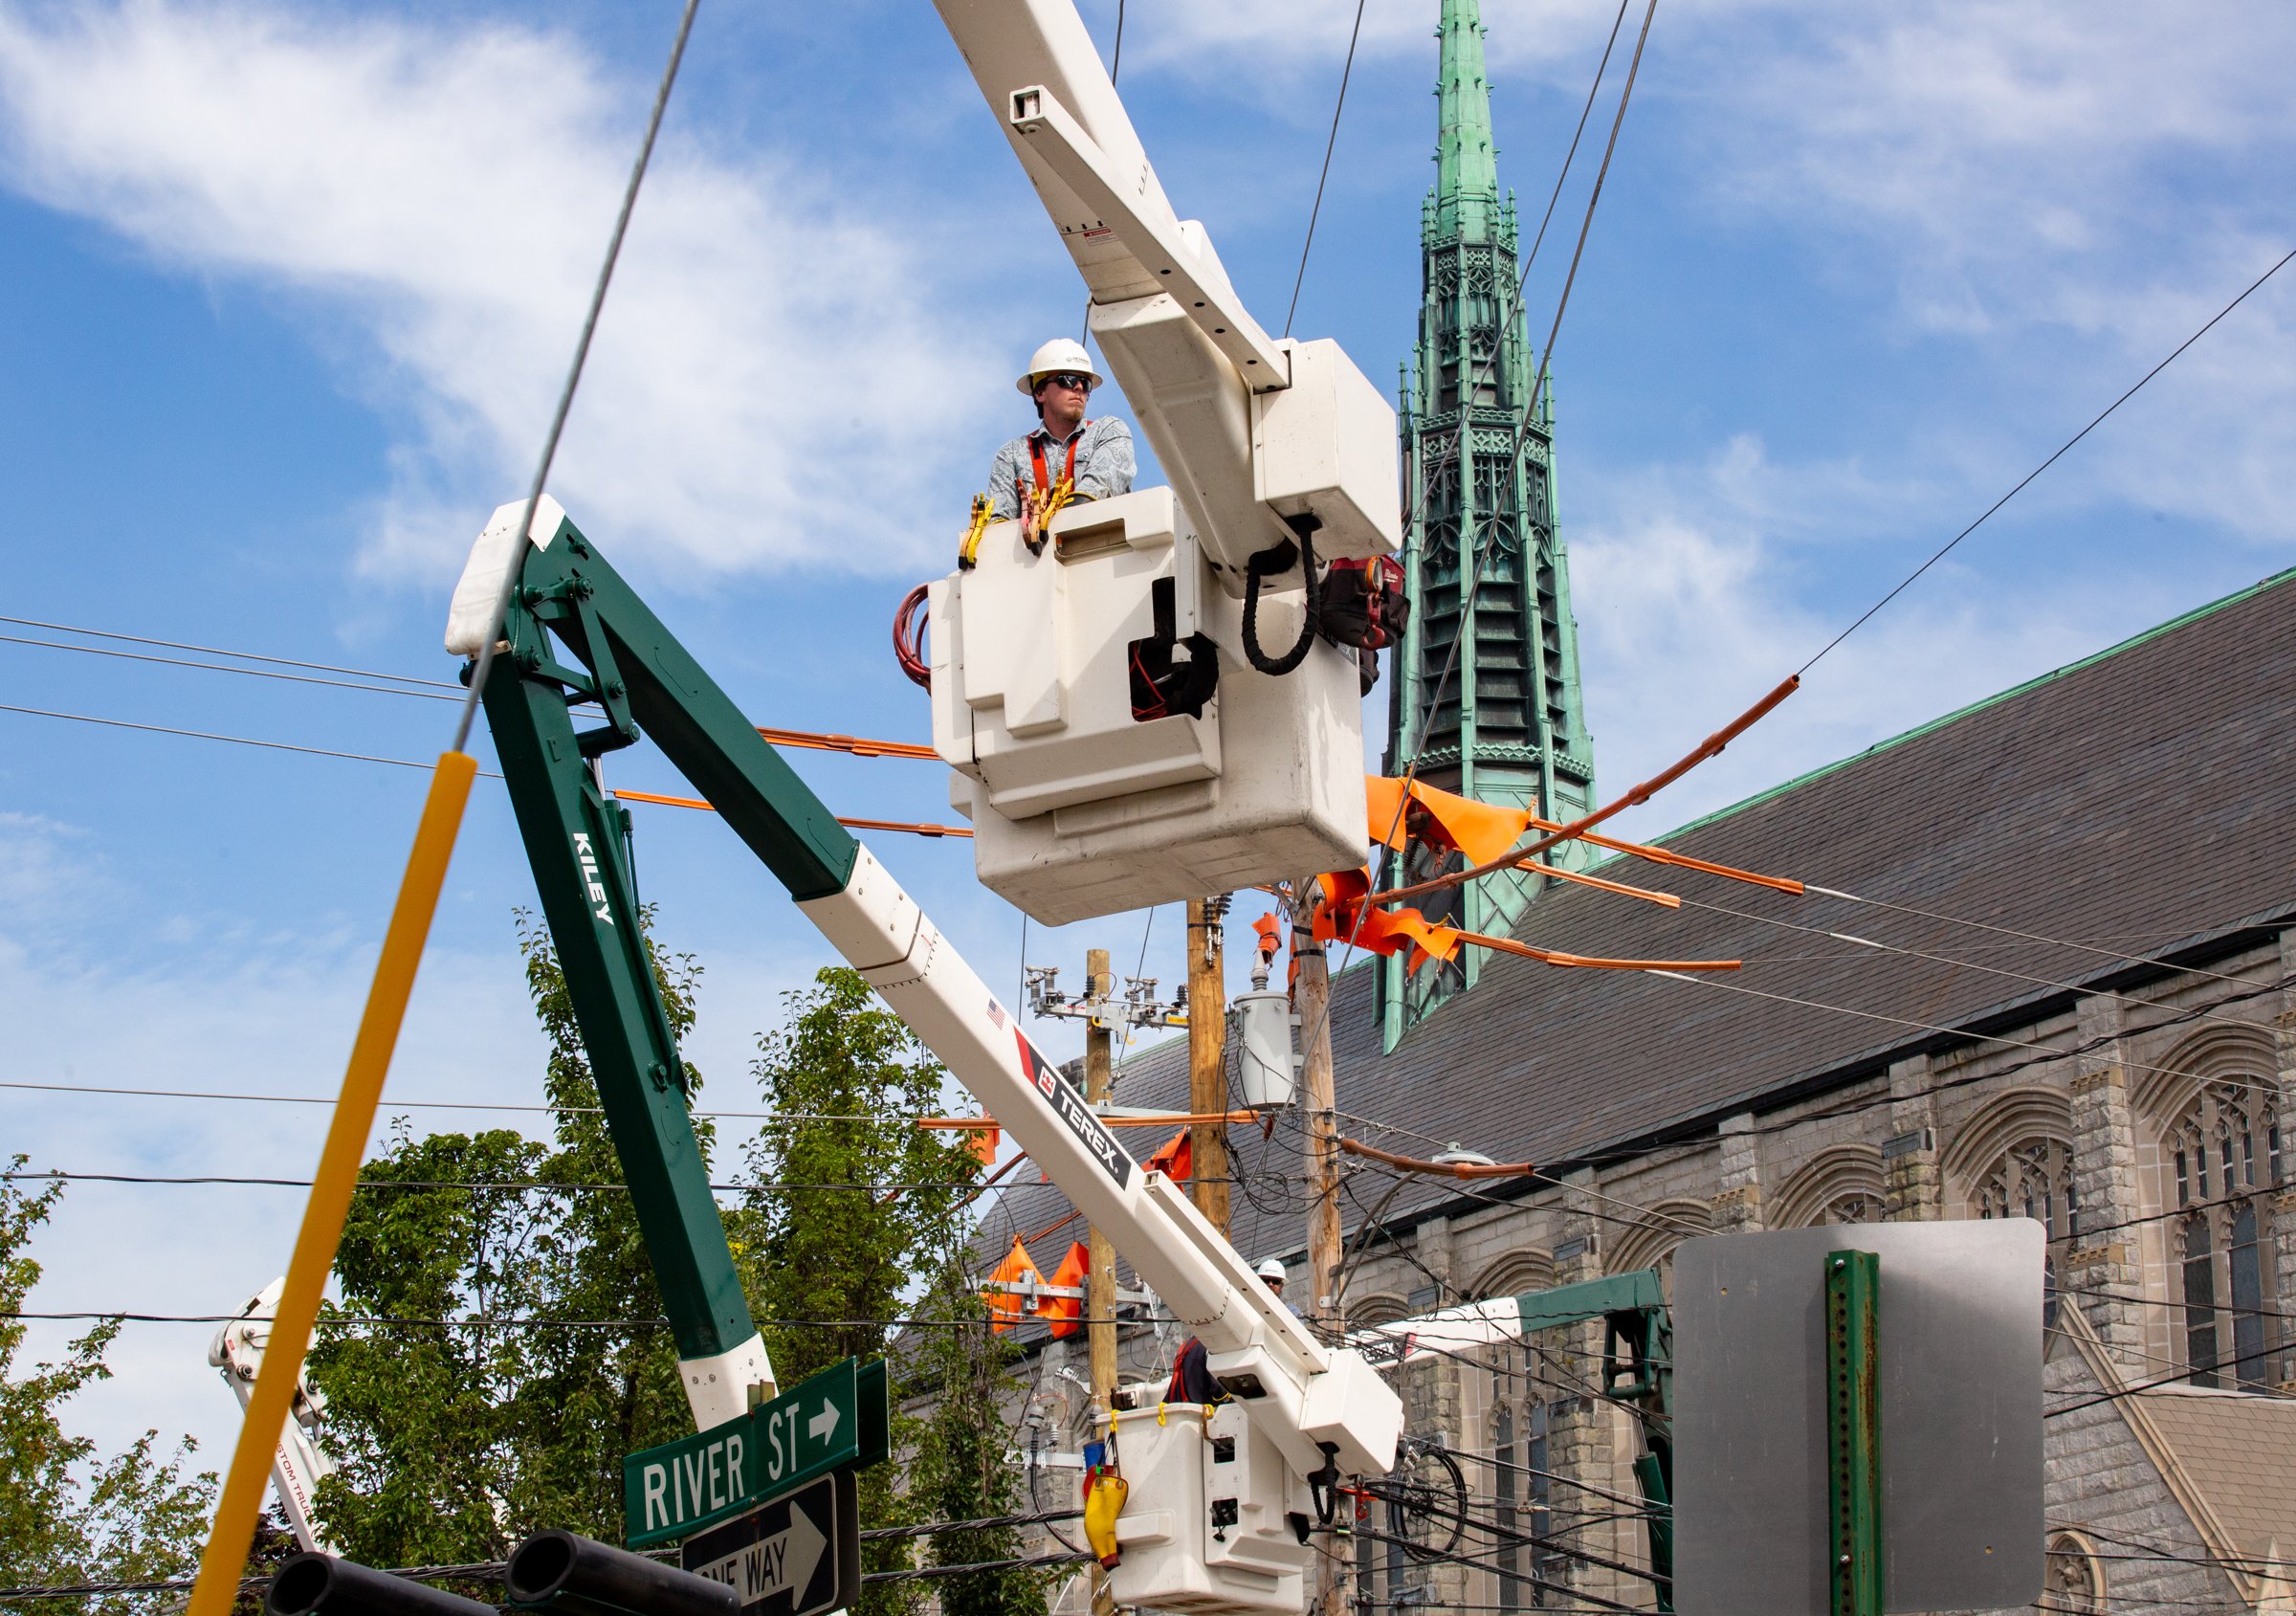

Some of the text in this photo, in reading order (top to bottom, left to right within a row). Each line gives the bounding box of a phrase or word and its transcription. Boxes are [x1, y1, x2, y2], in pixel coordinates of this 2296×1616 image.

[573, 832, 614, 926] KILEY
[1060, 1089, 1117, 1170] TEREX
[644, 1402, 800, 1531] RIVER ST
[745, 1537, 787, 1597] WAY
